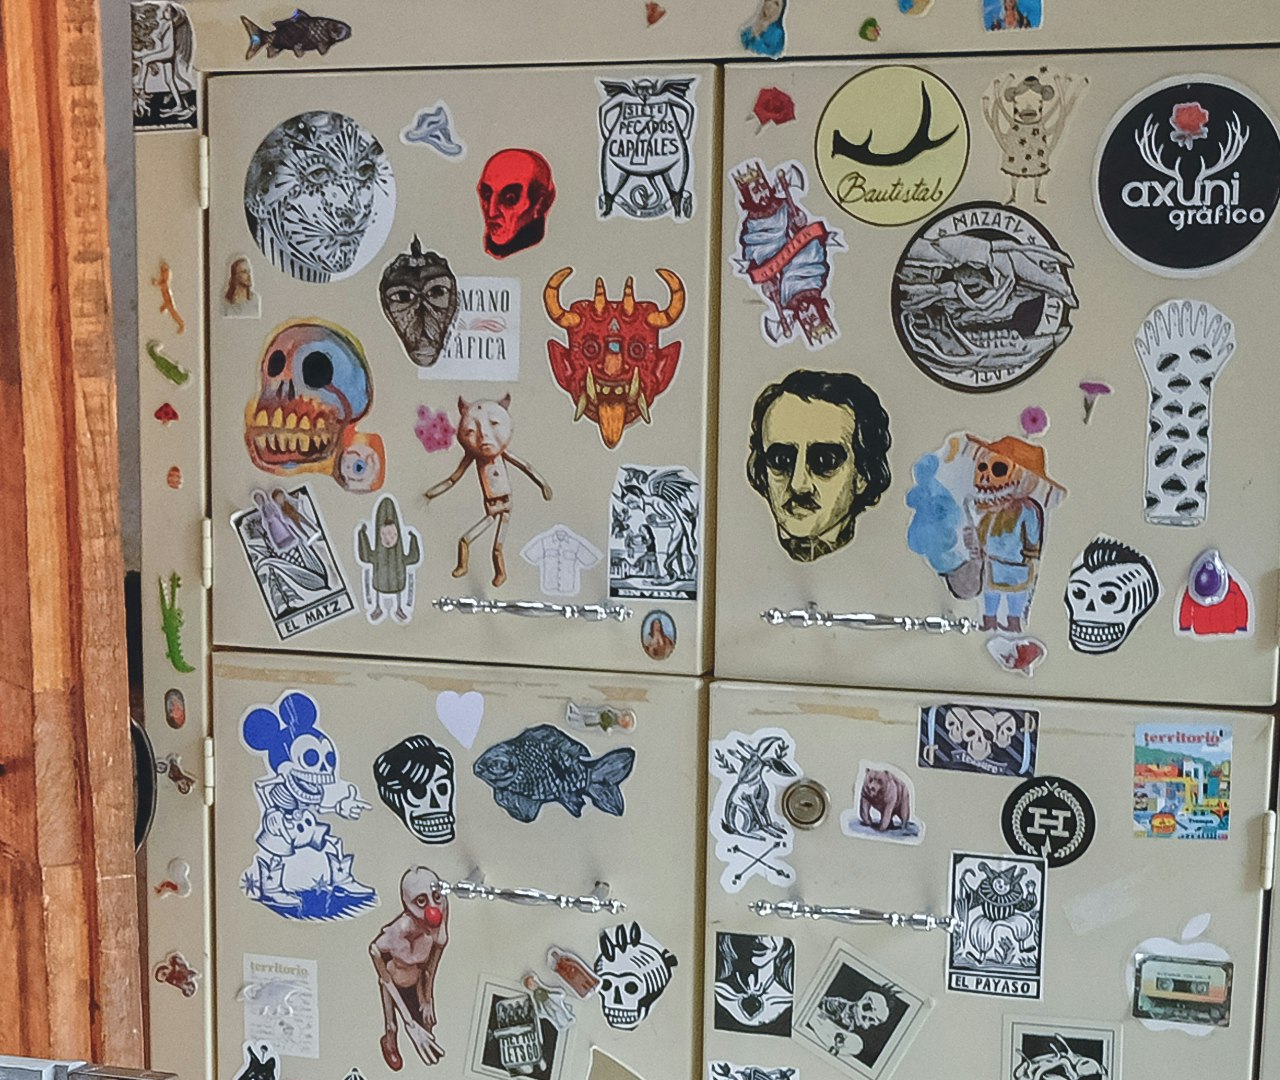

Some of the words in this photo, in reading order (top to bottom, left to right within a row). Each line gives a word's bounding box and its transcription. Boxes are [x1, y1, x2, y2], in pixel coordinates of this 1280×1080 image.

[626, 104, 664, 116] SIETE
[618, 119, 675, 136] PECADOS
[608, 137, 680, 158] CAPITALES
[1121, 171, 1240, 208] axuni
[951, 210, 1026, 234] MAZATL
[617, 588, 690, 599] ENVIDIA
[284, 622, 300, 635] EL
[305, 600, 342, 626] MAIZ
[1143, 730, 1221, 745] territorio
[250, 961, 309, 977] territorio
[954, 975, 969, 989] EL
[974, 977, 1032, 995] PAYASO
